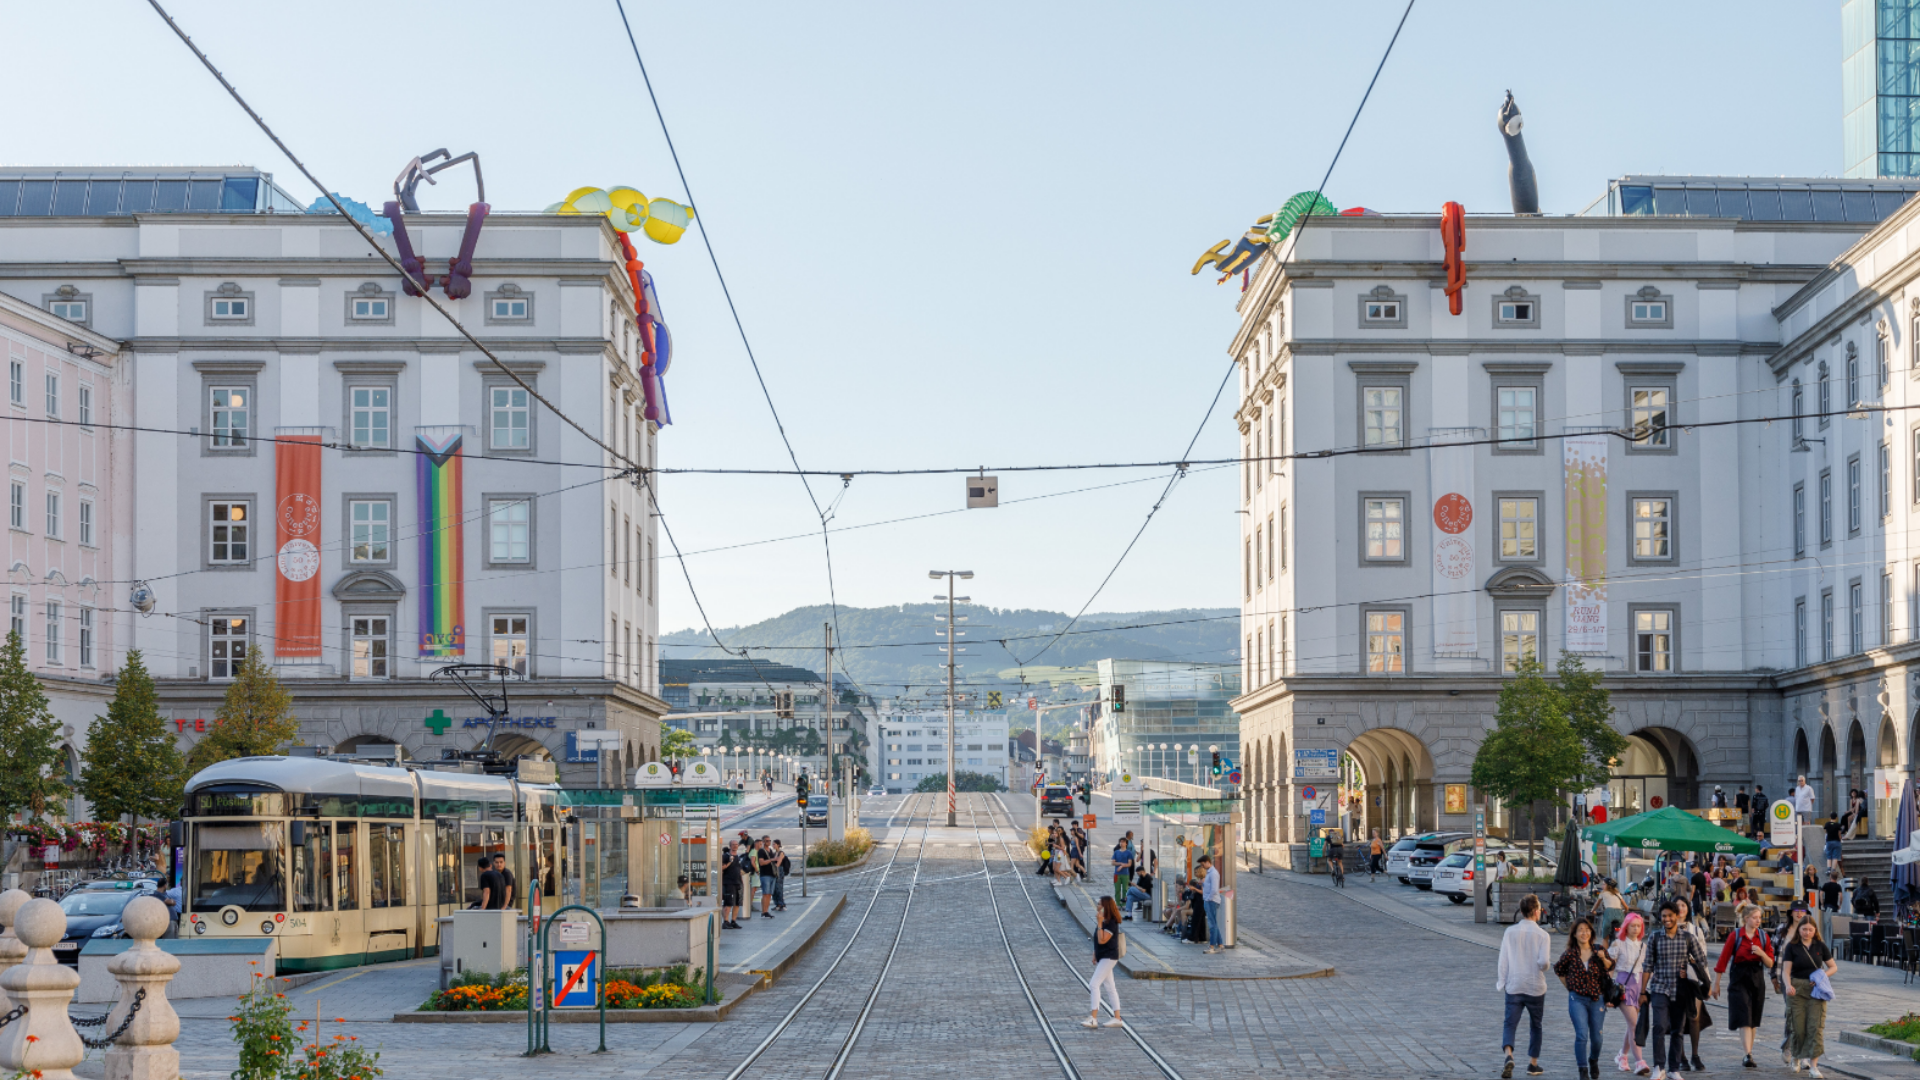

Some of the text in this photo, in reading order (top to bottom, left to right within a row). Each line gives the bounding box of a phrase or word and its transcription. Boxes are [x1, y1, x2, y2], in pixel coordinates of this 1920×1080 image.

[1574, 607, 1600, 615] RUND
[1573, 615, 1600, 624] GANG
[201, 796, 212, 808] 50
[290, 918, 307, 929] 504
